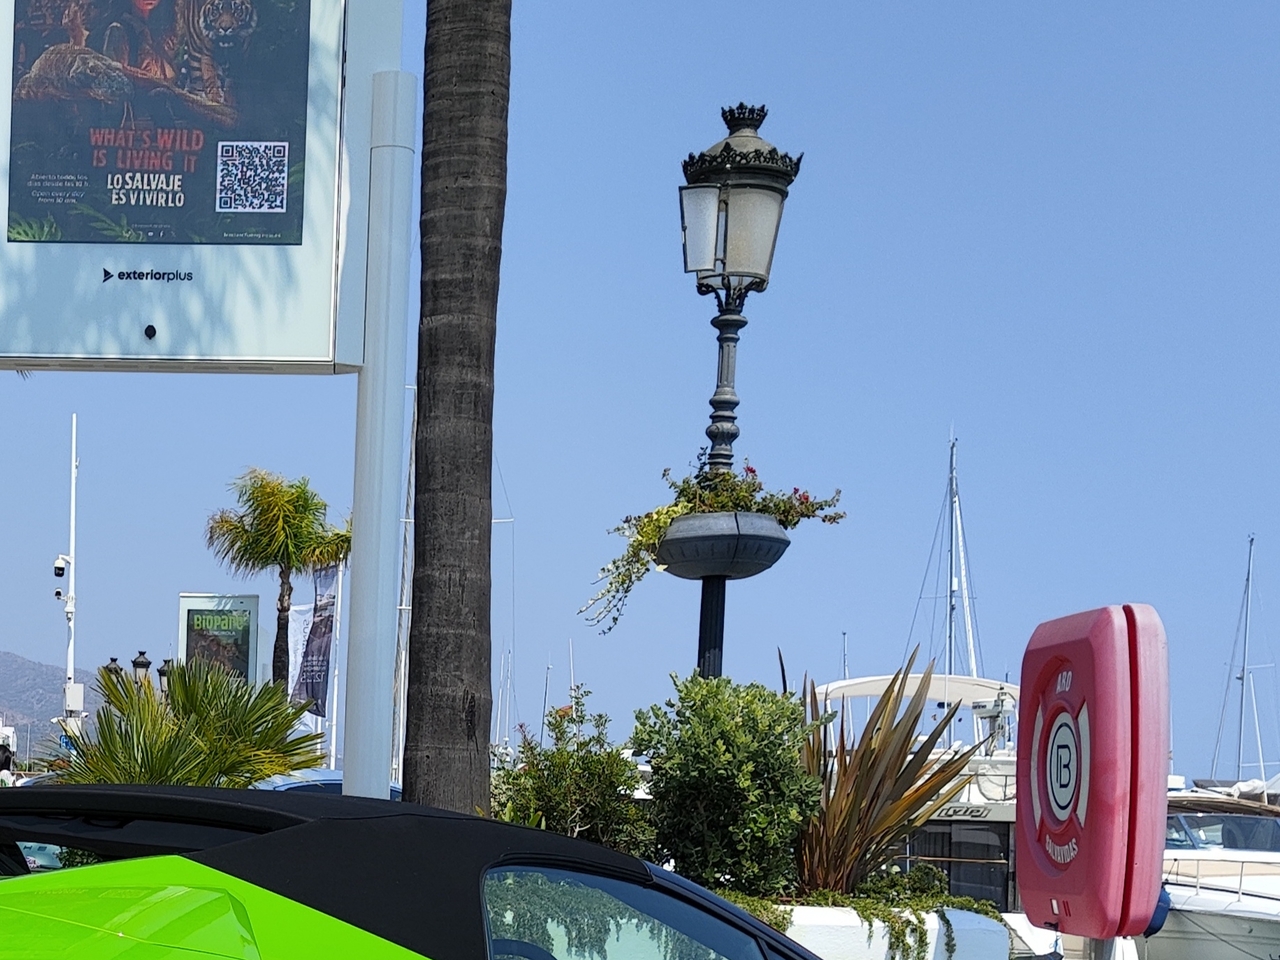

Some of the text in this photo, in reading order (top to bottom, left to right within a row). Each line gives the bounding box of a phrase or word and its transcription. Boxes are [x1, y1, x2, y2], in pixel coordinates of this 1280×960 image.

[89, 128, 205, 151] WHAT'S WILD
[92, 149, 198, 173] IS LIVING IT
[107, 172, 183, 191] LO SALVAJE
[111, 190, 185, 207] ES VIVIRLO
[118, 268, 194, 284] exteriorplus
[1055, 670, 1073, 694] ARO
[1045, 833, 1079, 864] SALVAVIDAS
